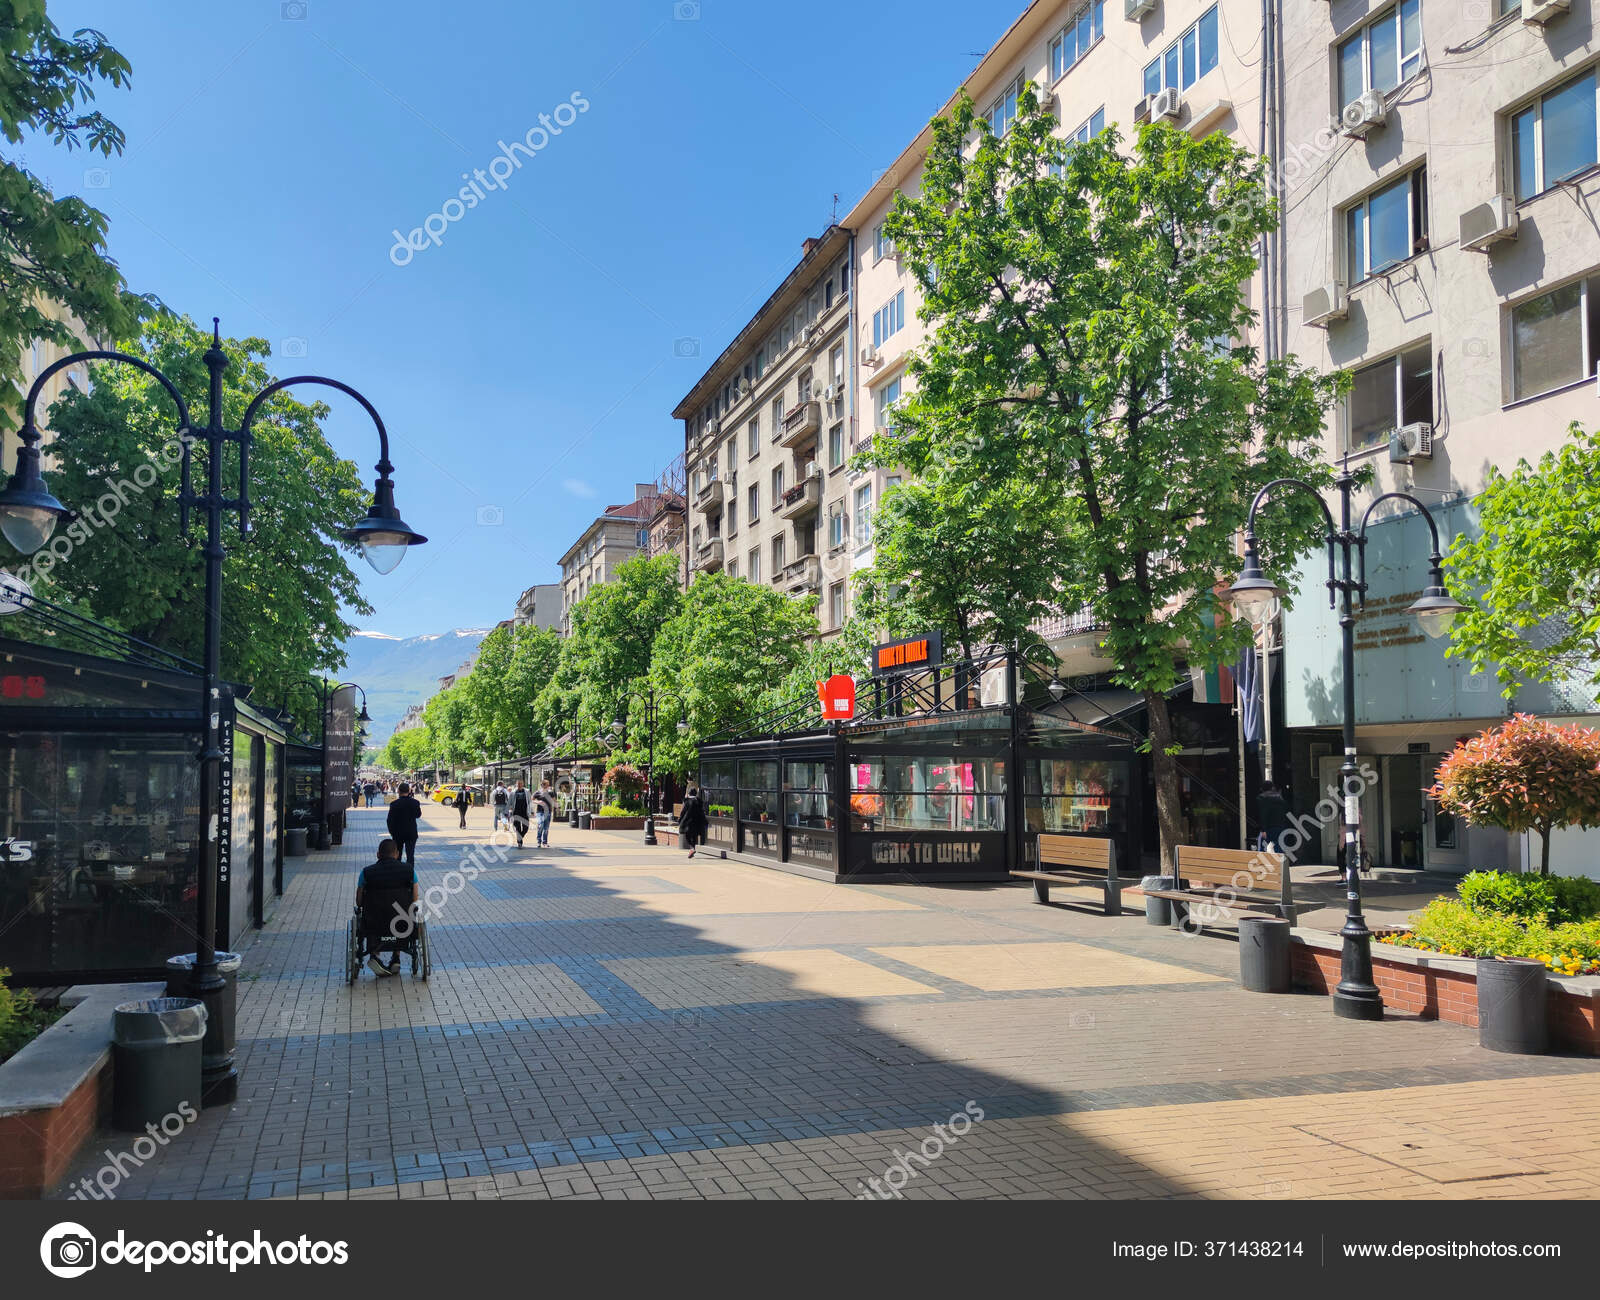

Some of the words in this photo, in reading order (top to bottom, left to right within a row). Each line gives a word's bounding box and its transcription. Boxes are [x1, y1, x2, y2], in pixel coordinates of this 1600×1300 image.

[223, 721, 231, 762] PIZZA
[222, 771, 230, 822] BURGER
[220, 829, 229, 881] SALADS
[914, 843, 933, 863] TO
[937, 842, 981, 863] WALK
